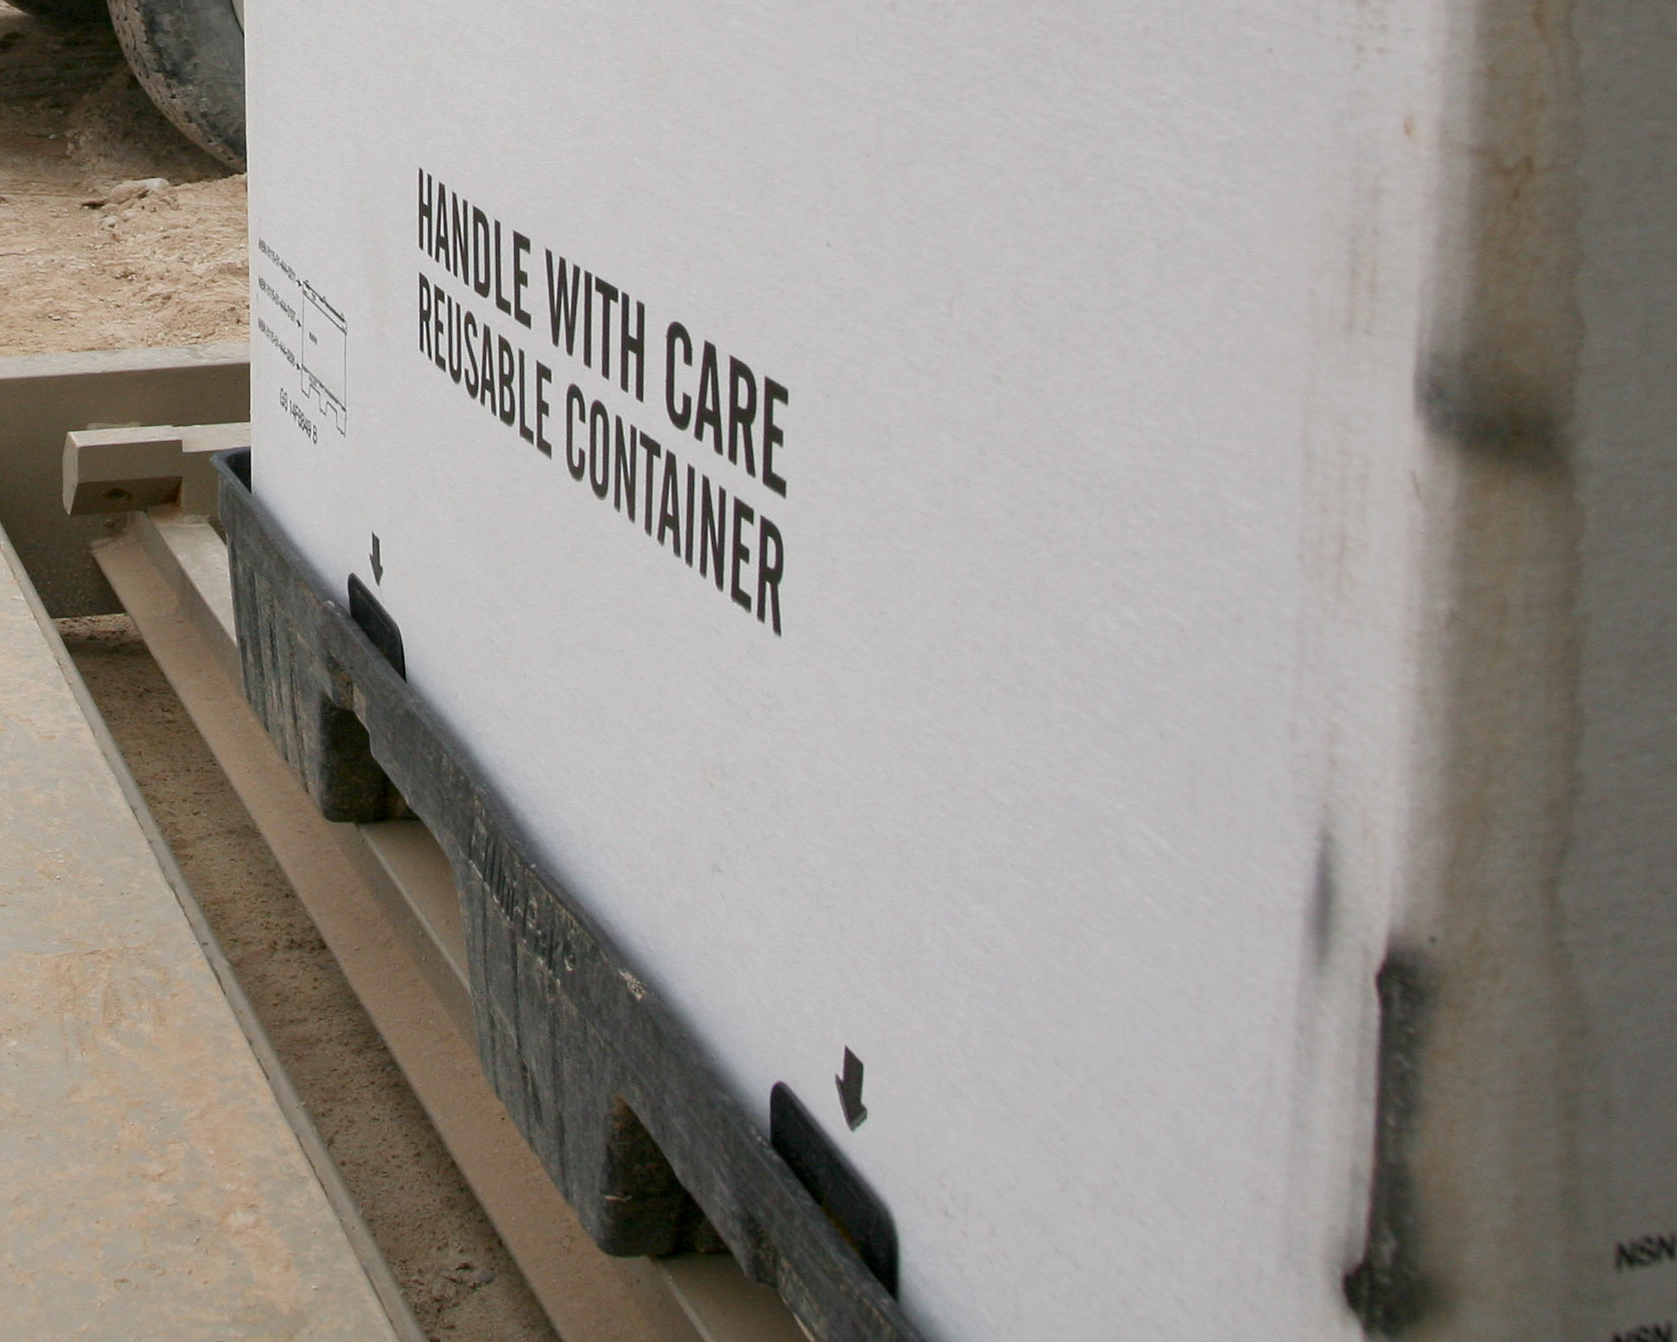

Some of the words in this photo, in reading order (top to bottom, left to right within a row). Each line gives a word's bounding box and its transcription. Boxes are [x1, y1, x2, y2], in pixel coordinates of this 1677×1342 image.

[418, 167, 531, 329] HANDLE
[545, 246, 645, 402] WITH
[666, 321, 789, 499] CARE
[418, 272, 552, 459] REUSABLE
[565, 383, 784, 637] CONTAINER
[1615, 1233, 1676, 1271] NSN
